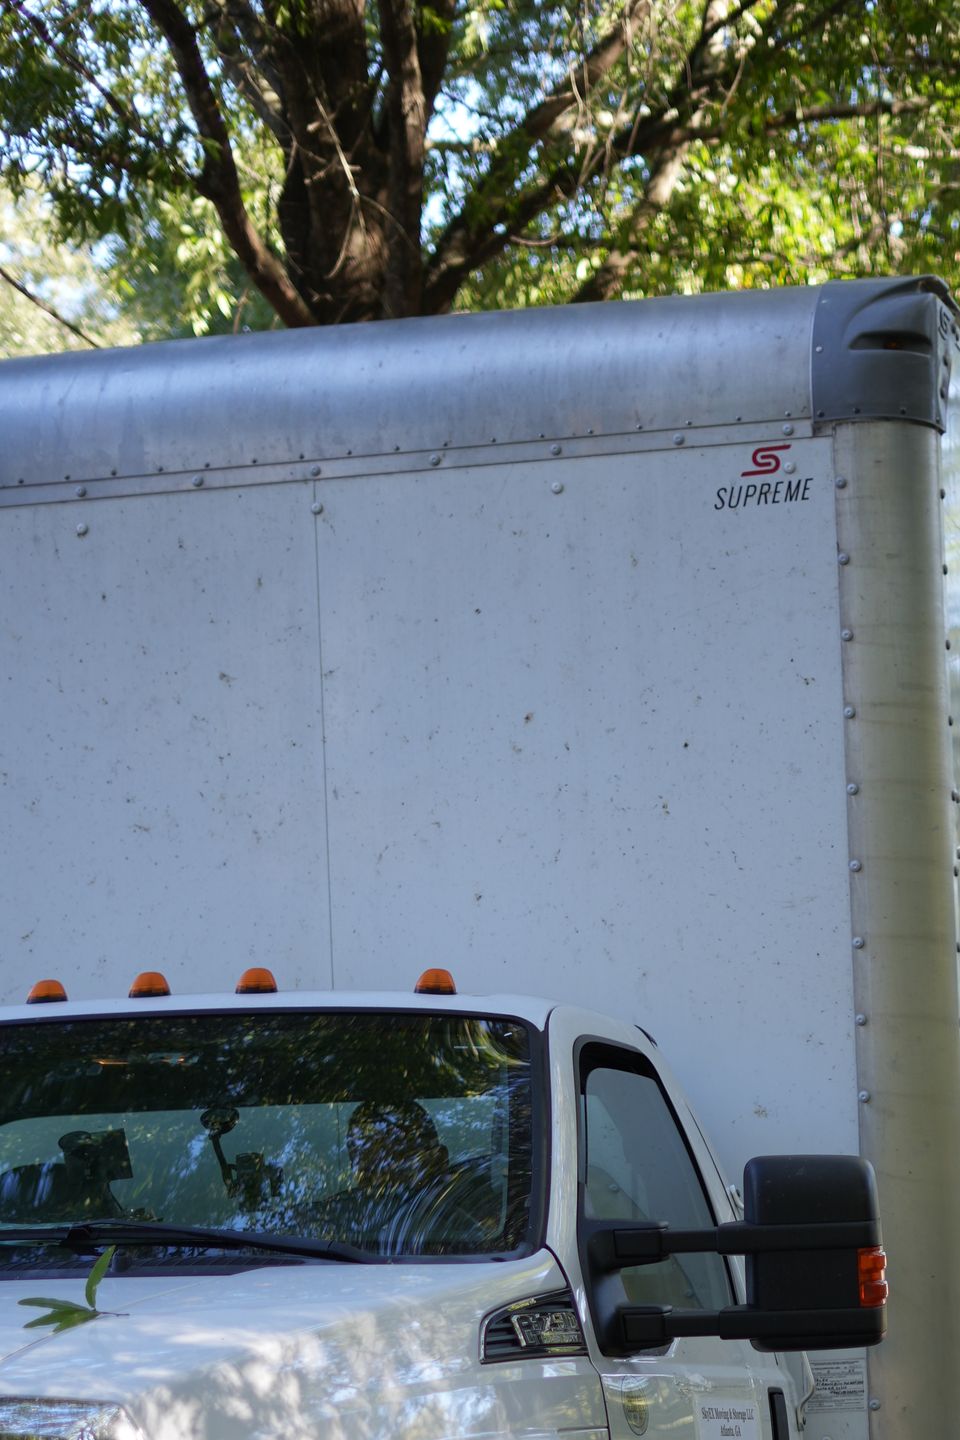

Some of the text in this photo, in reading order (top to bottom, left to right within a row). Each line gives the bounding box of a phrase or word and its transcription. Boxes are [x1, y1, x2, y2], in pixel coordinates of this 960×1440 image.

[714, 478, 813, 510] SUPREME
[715, 1408, 729, 1422] Moving
[732, 1408, 746, 1423] Storage
[746, 1409, 754, 1420] LLC
[735, 1425, 741, 1437] GA
